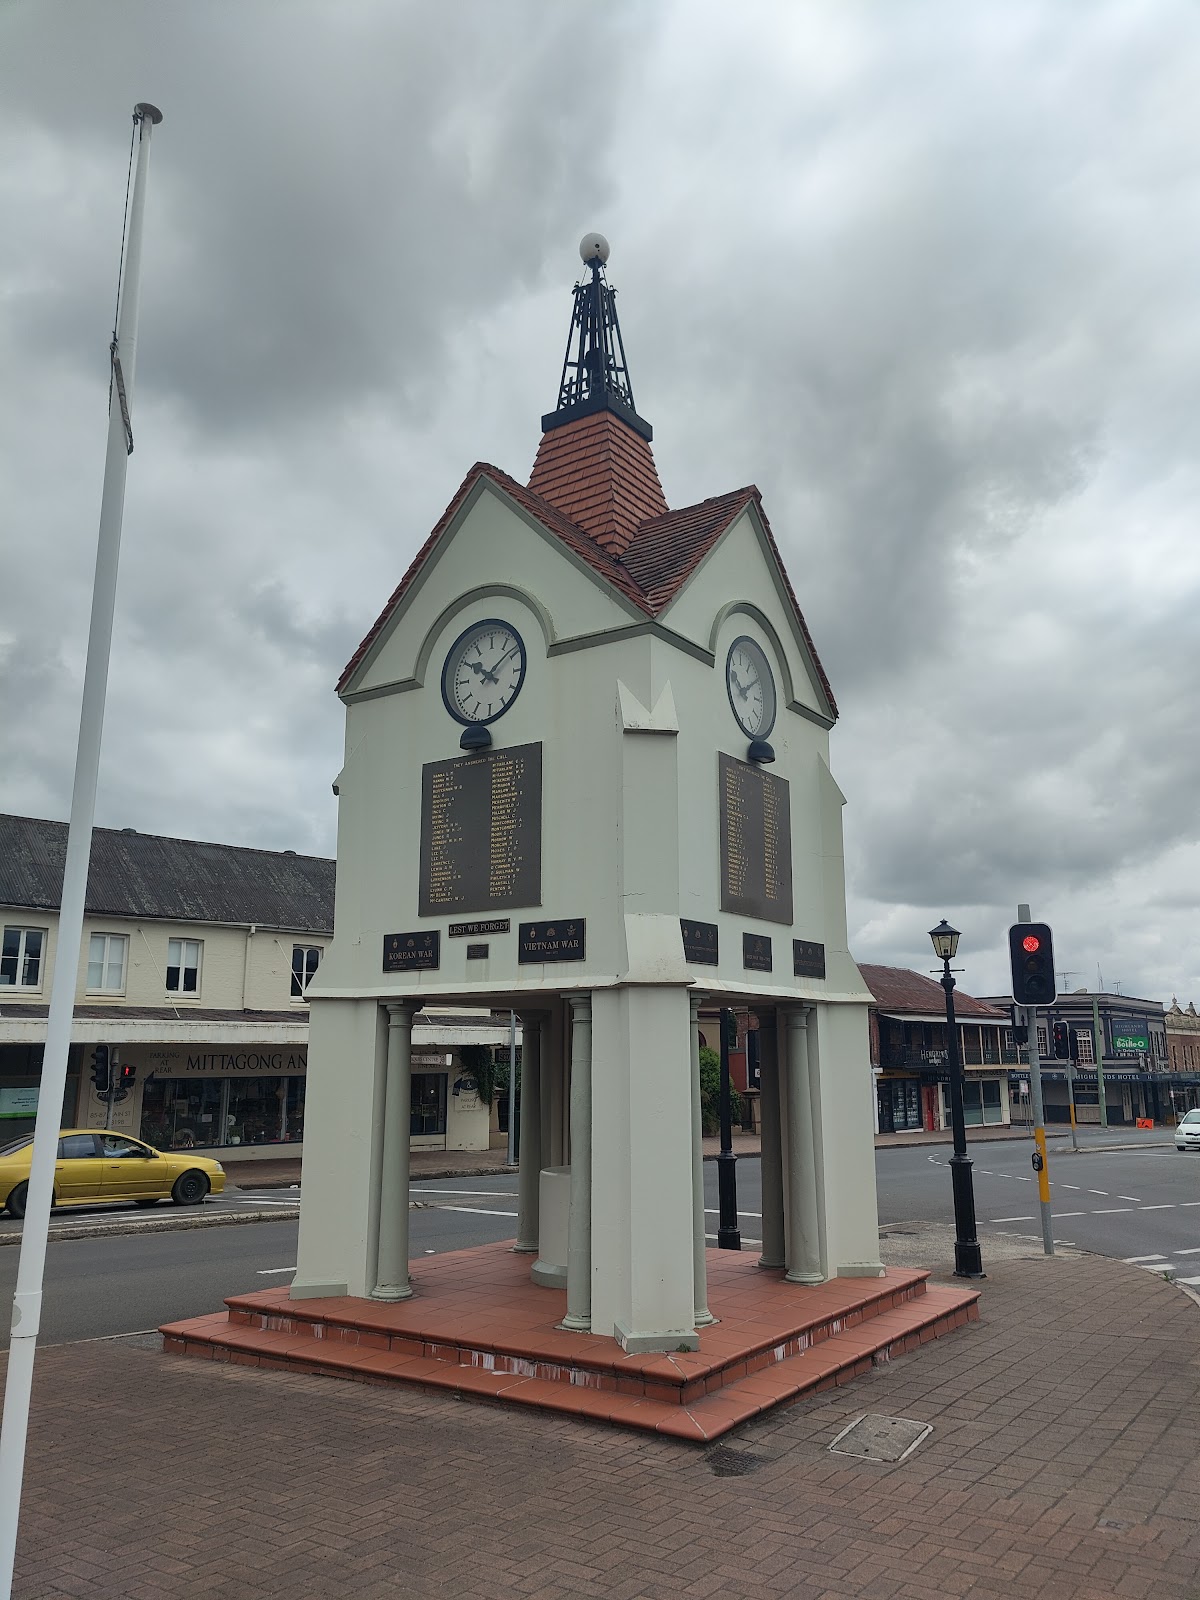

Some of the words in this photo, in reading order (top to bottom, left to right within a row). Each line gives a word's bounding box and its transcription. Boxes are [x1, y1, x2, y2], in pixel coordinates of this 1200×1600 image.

[450, 925, 467, 934] LEST
[468, 924, 478, 932] WE
[481, 922, 508, 931] FORGET
[524, 941, 559, 950] VIETNAM
[561, 940, 578, 948] WAR
[389, 951, 416, 960] KOREAN
[418, 950, 432, 958] WAR
[186, 1054, 282, 1070] MITTAGONG
